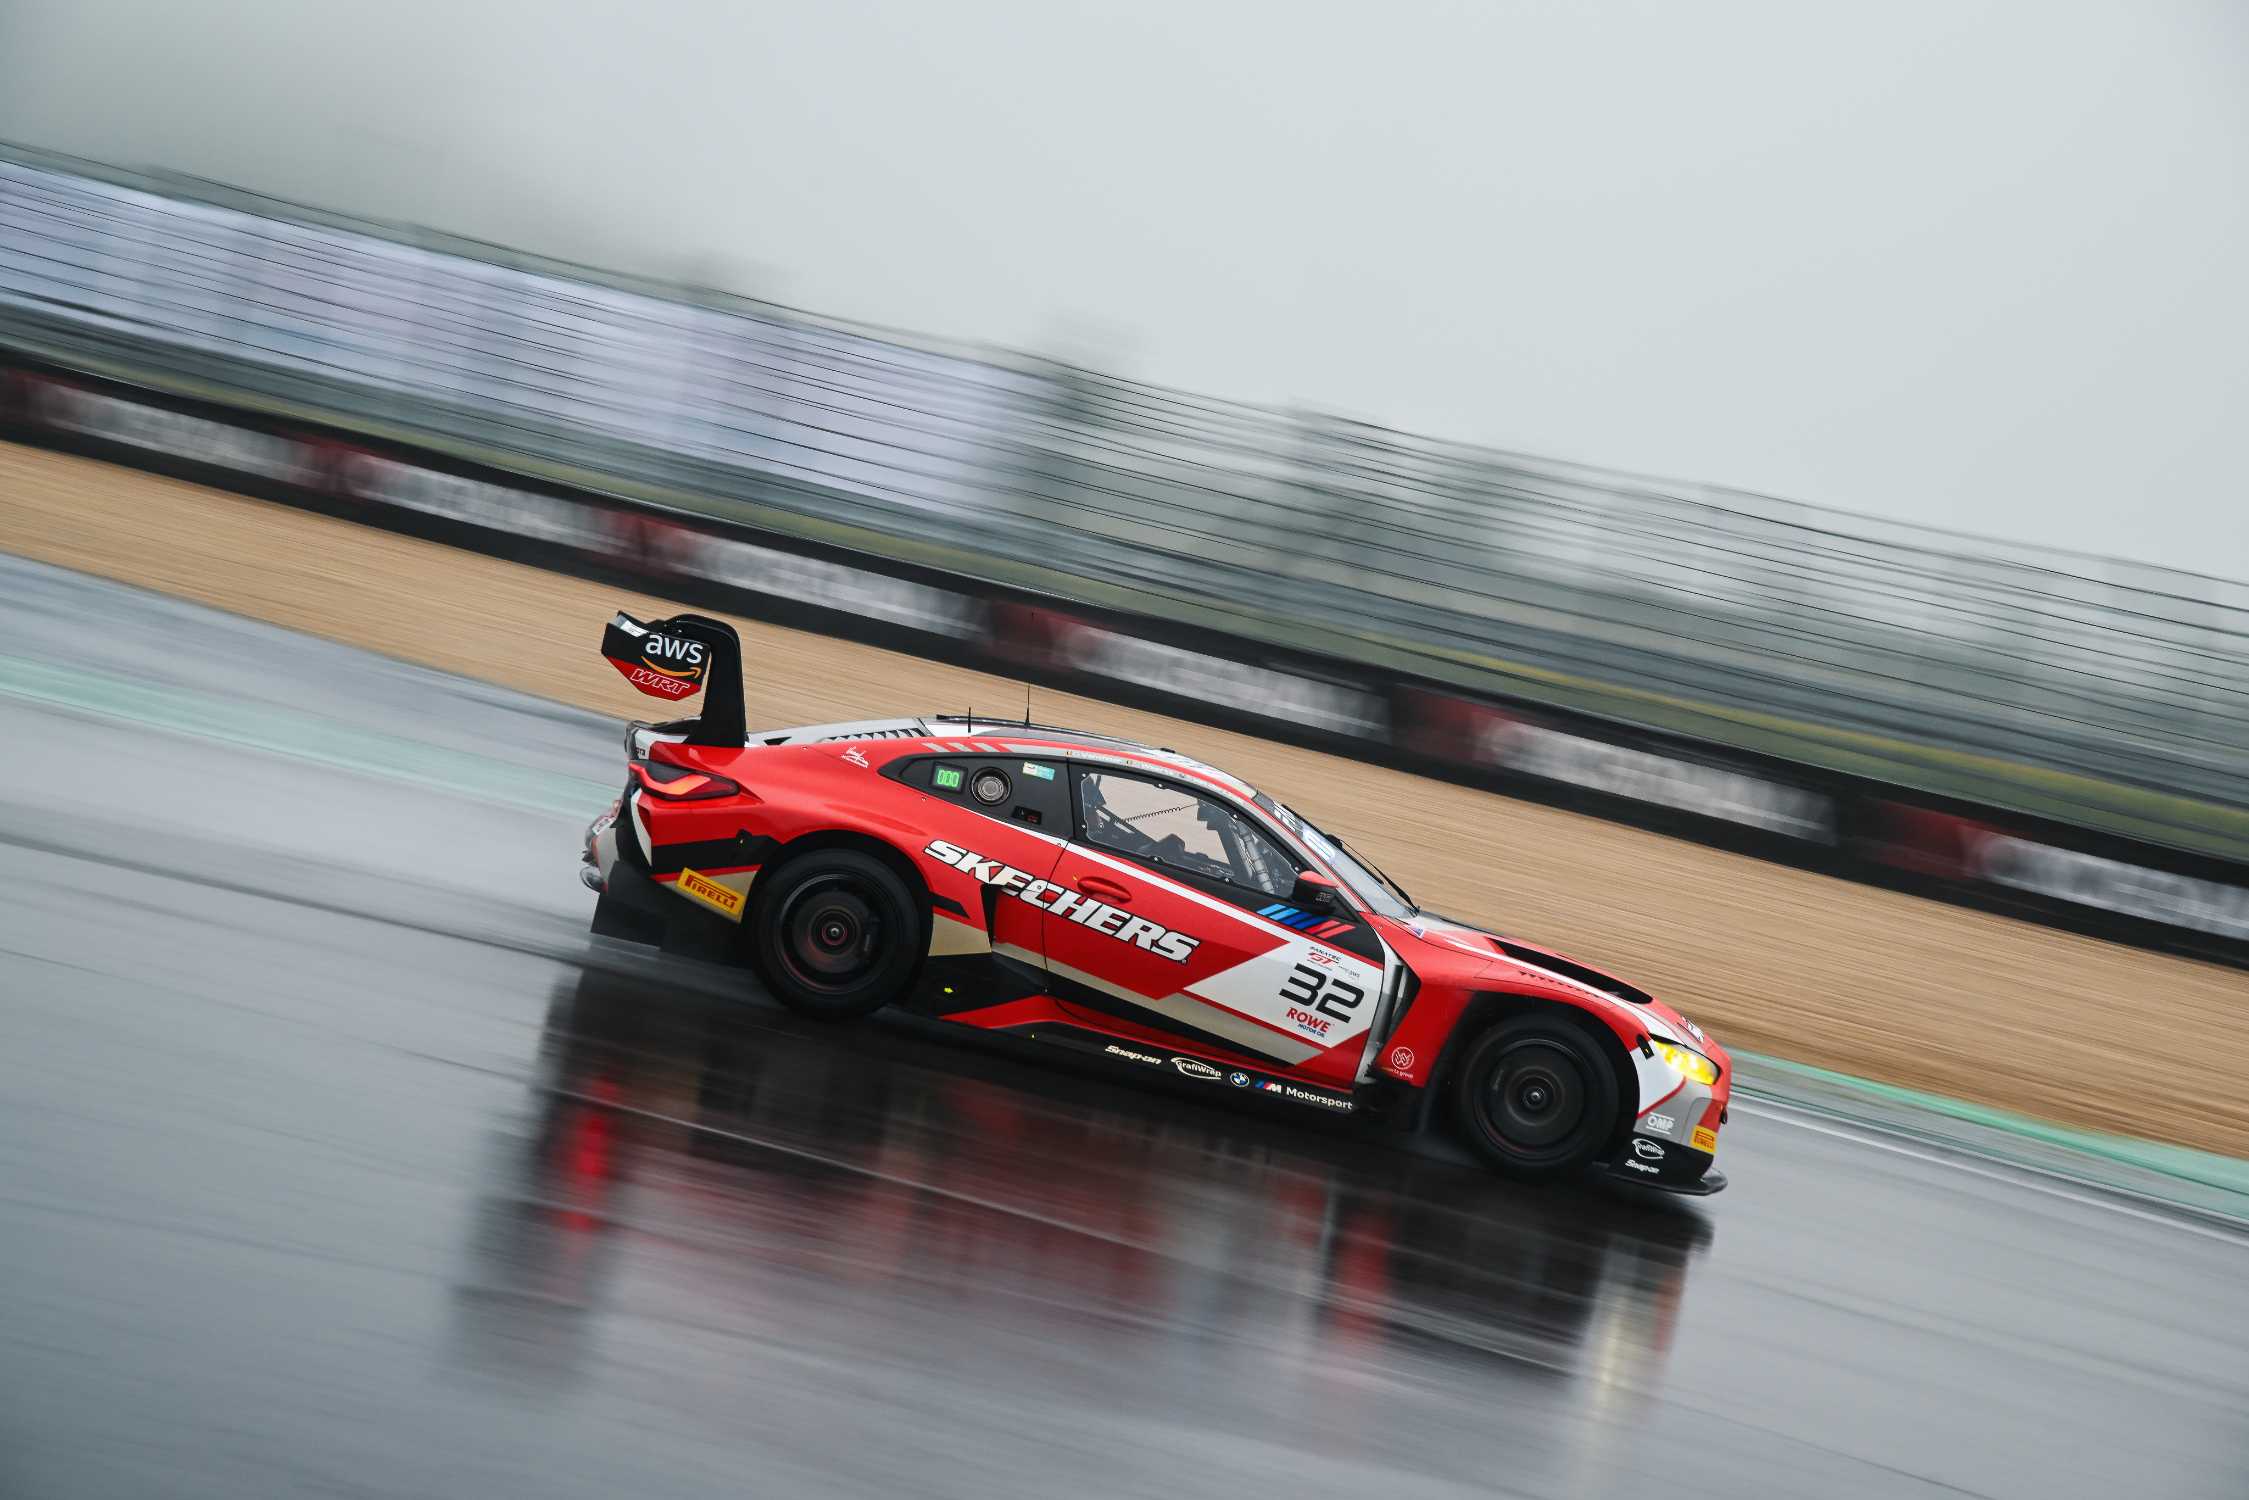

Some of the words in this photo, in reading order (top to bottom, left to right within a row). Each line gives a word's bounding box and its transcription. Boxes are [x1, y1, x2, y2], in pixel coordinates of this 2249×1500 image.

[645, 633, 703, 664] aws
[629, 668, 690, 695] WRT
[685, 874, 739, 909] PIRELLI
[924, 839, 1200, 962] SKECHERS
[1279, 963, 1365, 1024] 32
[1286, 1007, 1331, 1033] ROWE
[1286, 1086, 1353, 1110] Motorsport
